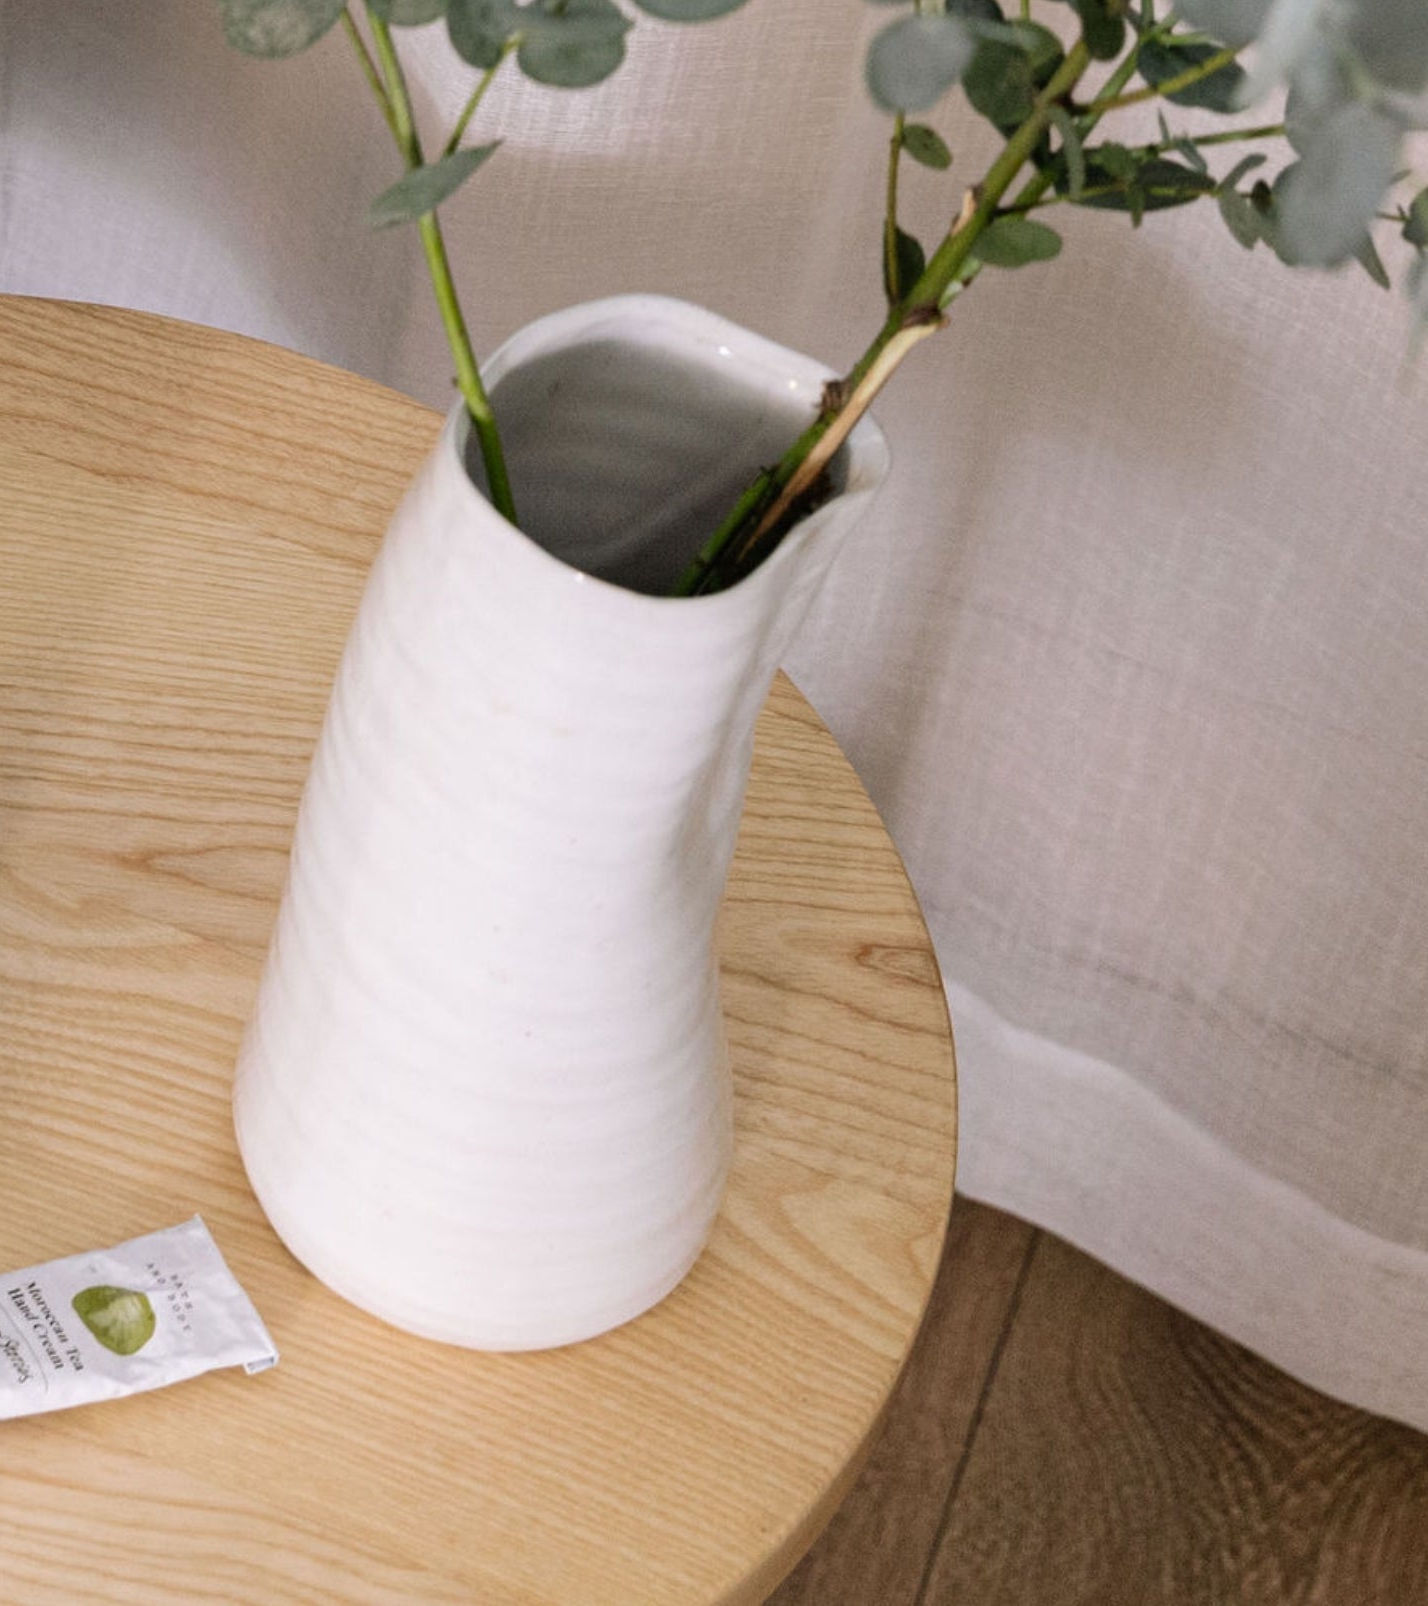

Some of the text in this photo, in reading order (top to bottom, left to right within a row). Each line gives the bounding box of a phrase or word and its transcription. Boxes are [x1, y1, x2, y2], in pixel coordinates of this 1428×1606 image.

[167, 1294, 192, 1332] BODY
[170, 1275, 193, 1310] BATH
[8, 1287, 64, 1370] Hand Cream
[27, 1281, 84, 1372] Moroccan Tea
